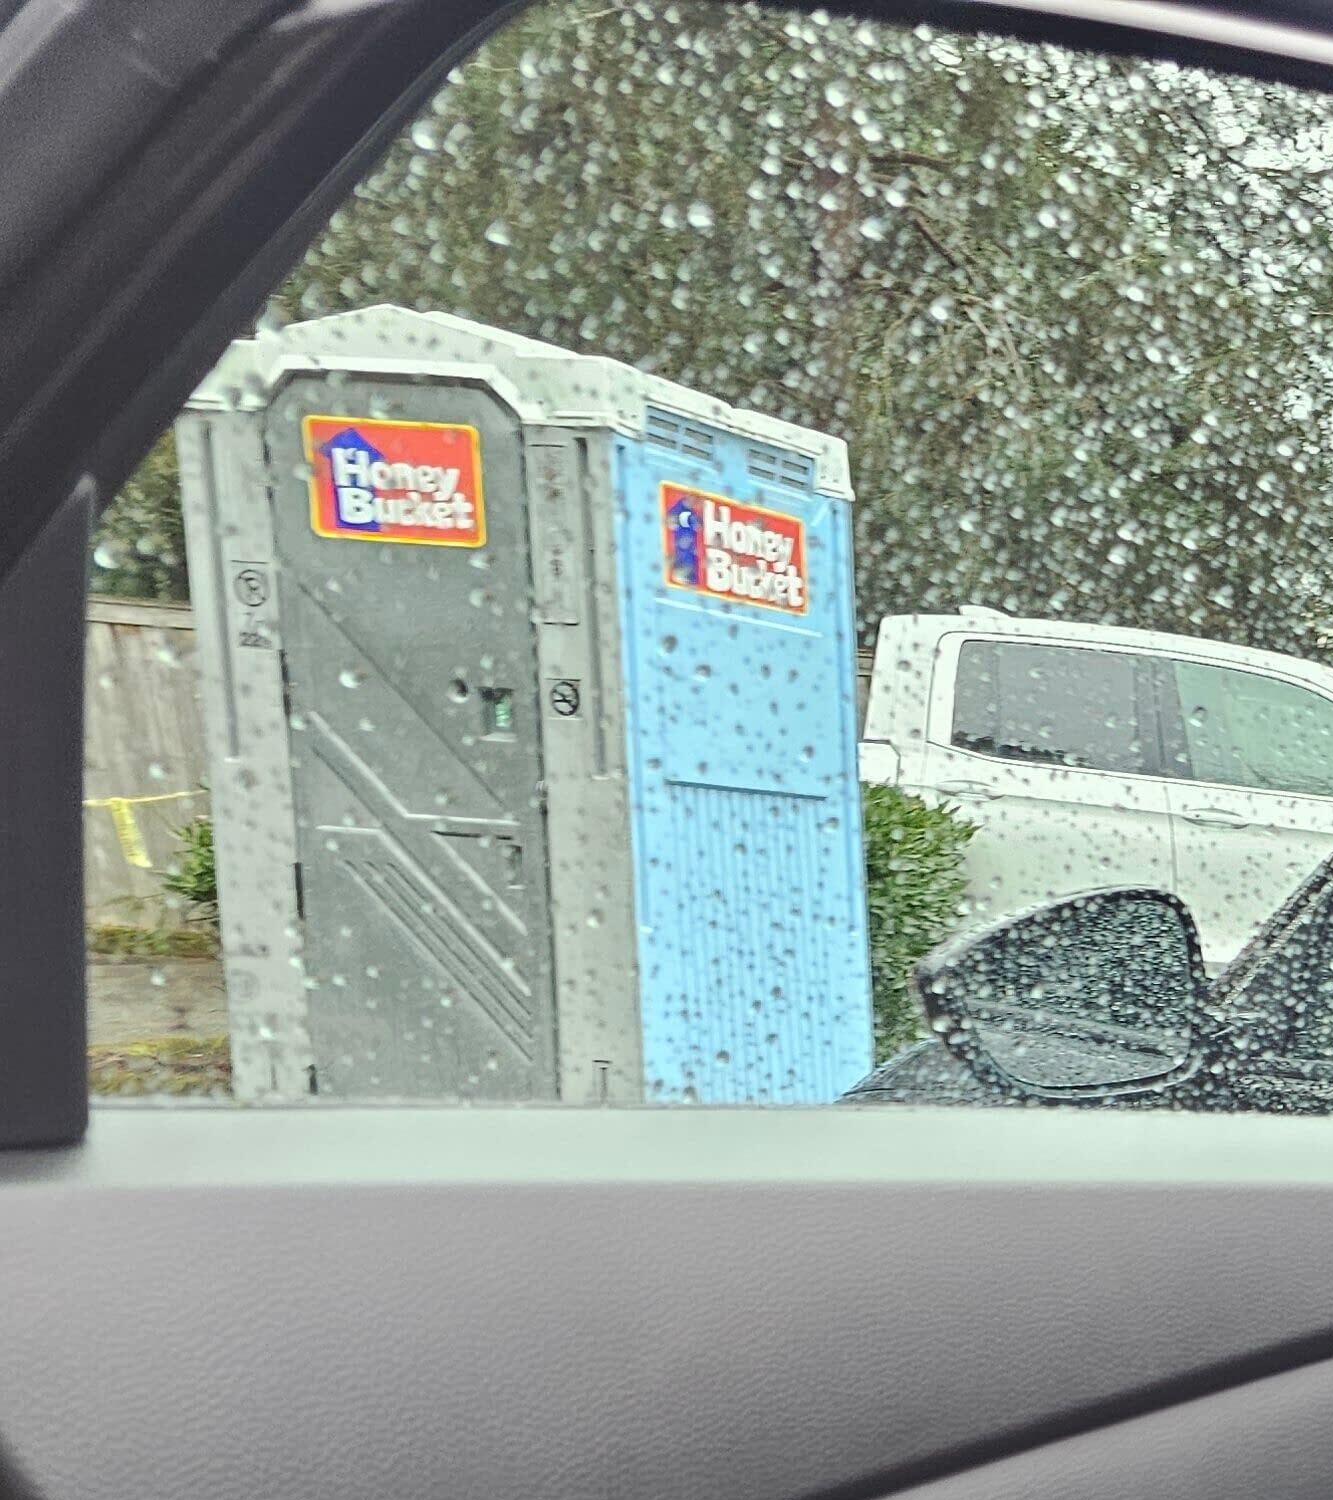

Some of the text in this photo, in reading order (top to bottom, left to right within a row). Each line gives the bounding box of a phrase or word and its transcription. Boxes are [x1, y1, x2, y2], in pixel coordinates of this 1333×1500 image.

[331, 447, 460, 501] Honey
[338, 487, 475, 529] Bucket
[703, 500, 794, 573] Honey
[705, 548, 803, 607] Bucket
